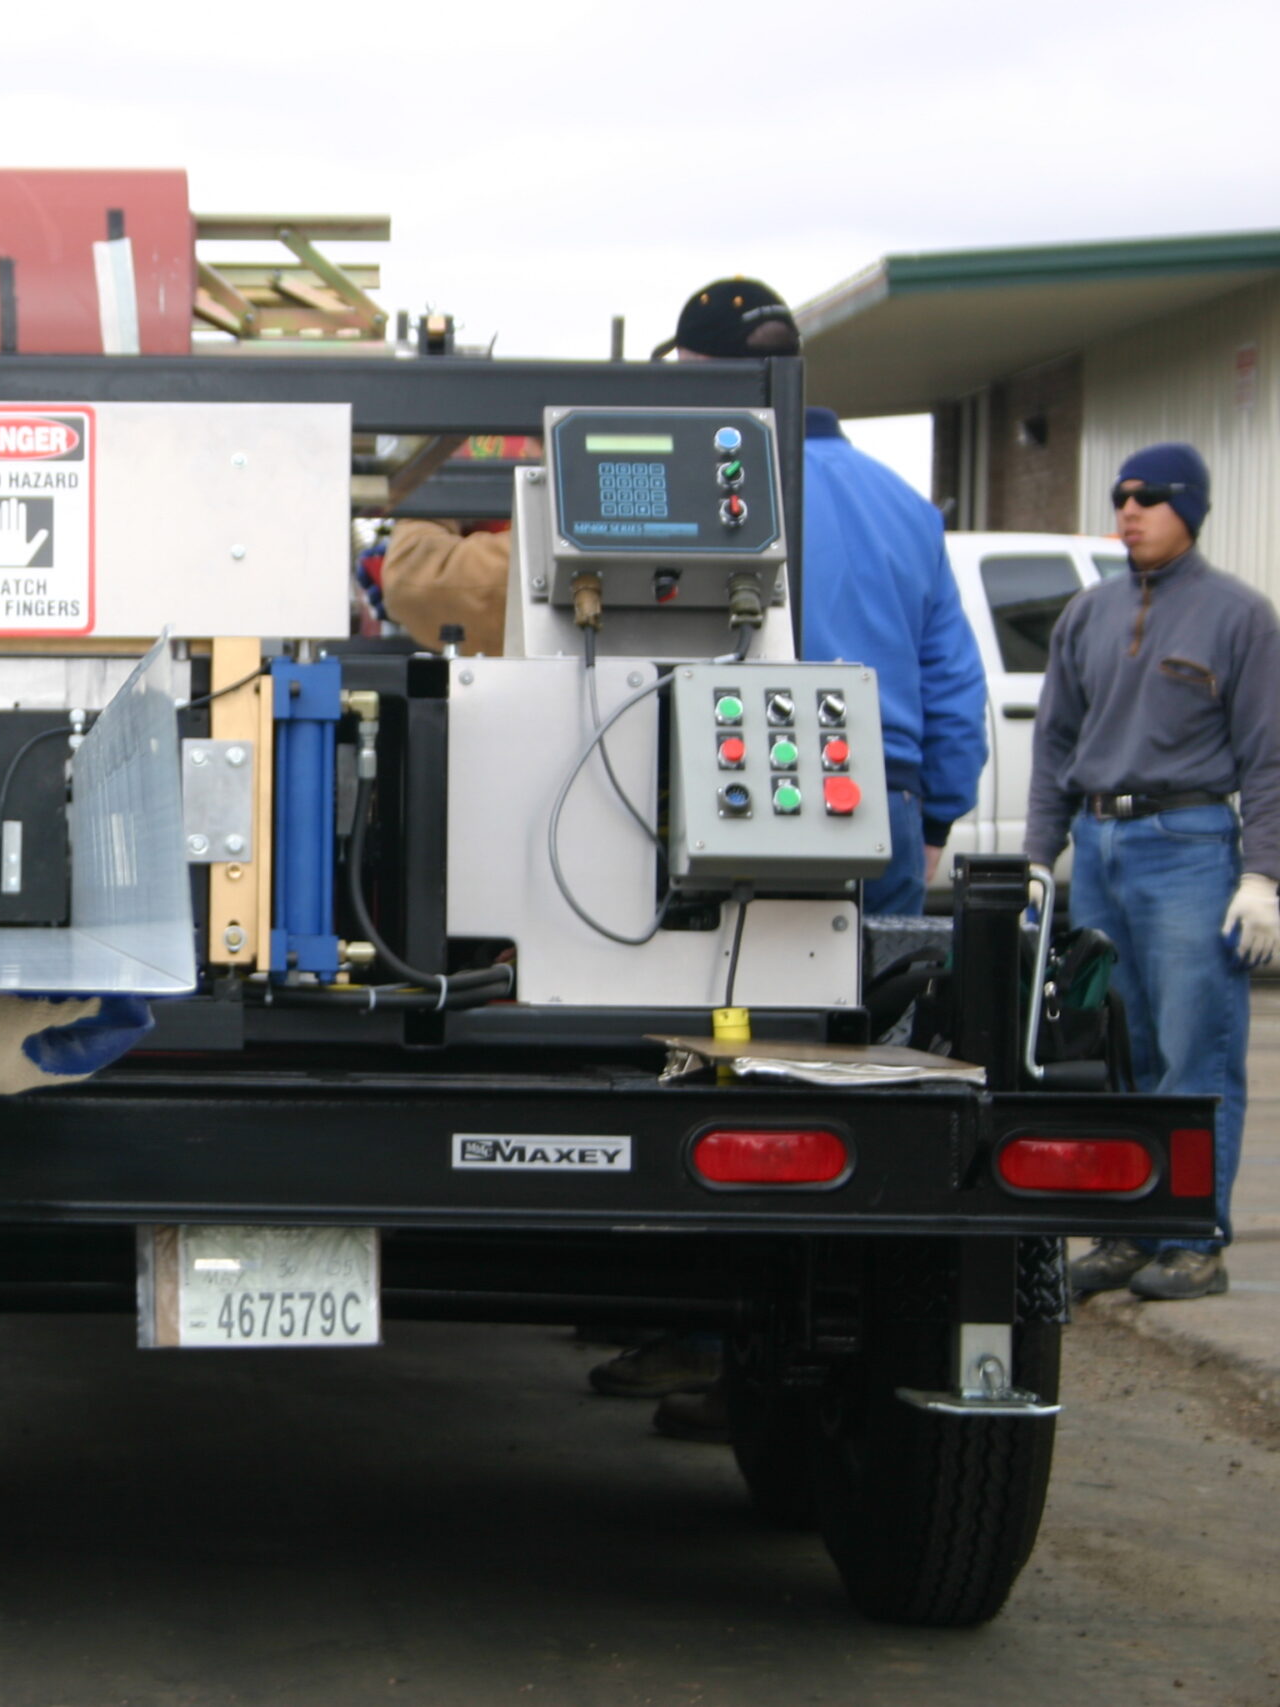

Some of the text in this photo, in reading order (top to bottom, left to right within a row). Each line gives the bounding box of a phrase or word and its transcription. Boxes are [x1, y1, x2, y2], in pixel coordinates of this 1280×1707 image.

[9, 472, 79, 488] HAZARD
[5, 599, 80, 616] FINGERS
[495, 1139, 623, 1164] MAXEY
[217, 1291, 362, 1339] 467579C
